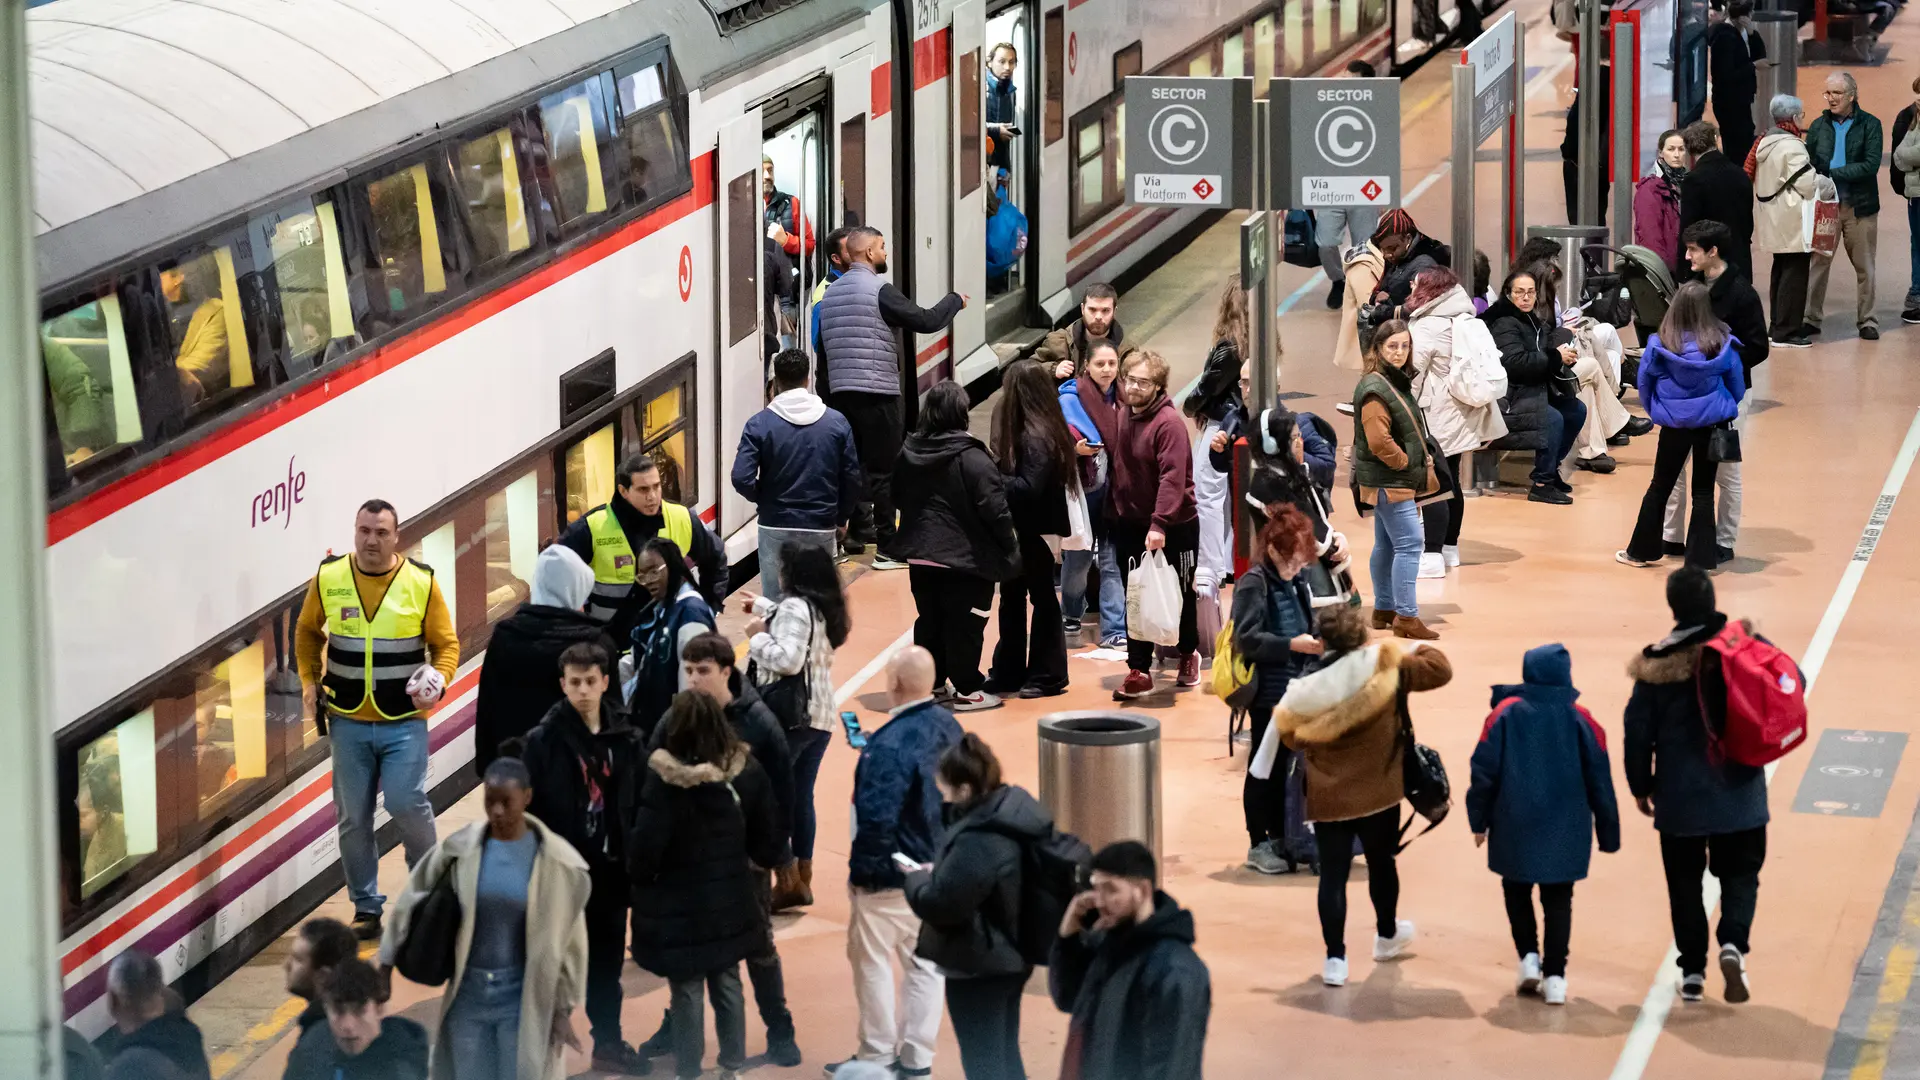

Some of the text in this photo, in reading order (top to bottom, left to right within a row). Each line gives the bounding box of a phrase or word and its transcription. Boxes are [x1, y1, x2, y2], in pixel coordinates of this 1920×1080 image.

[1151, 87, 1207, 100] SECTOR
[1317, 89, 1373, 101] SECTOR
[1161, 113, 1197, 155] C
[1327, 115, 1364, 157] C
[1143, 188, 1187, 201] Platform
[1198, 182, 1209, 196] 3
[1366, 183, 1377, 197] 4
[1310, 191, 1355, 204] Platform
[251, 454, 306, 530] renfe
